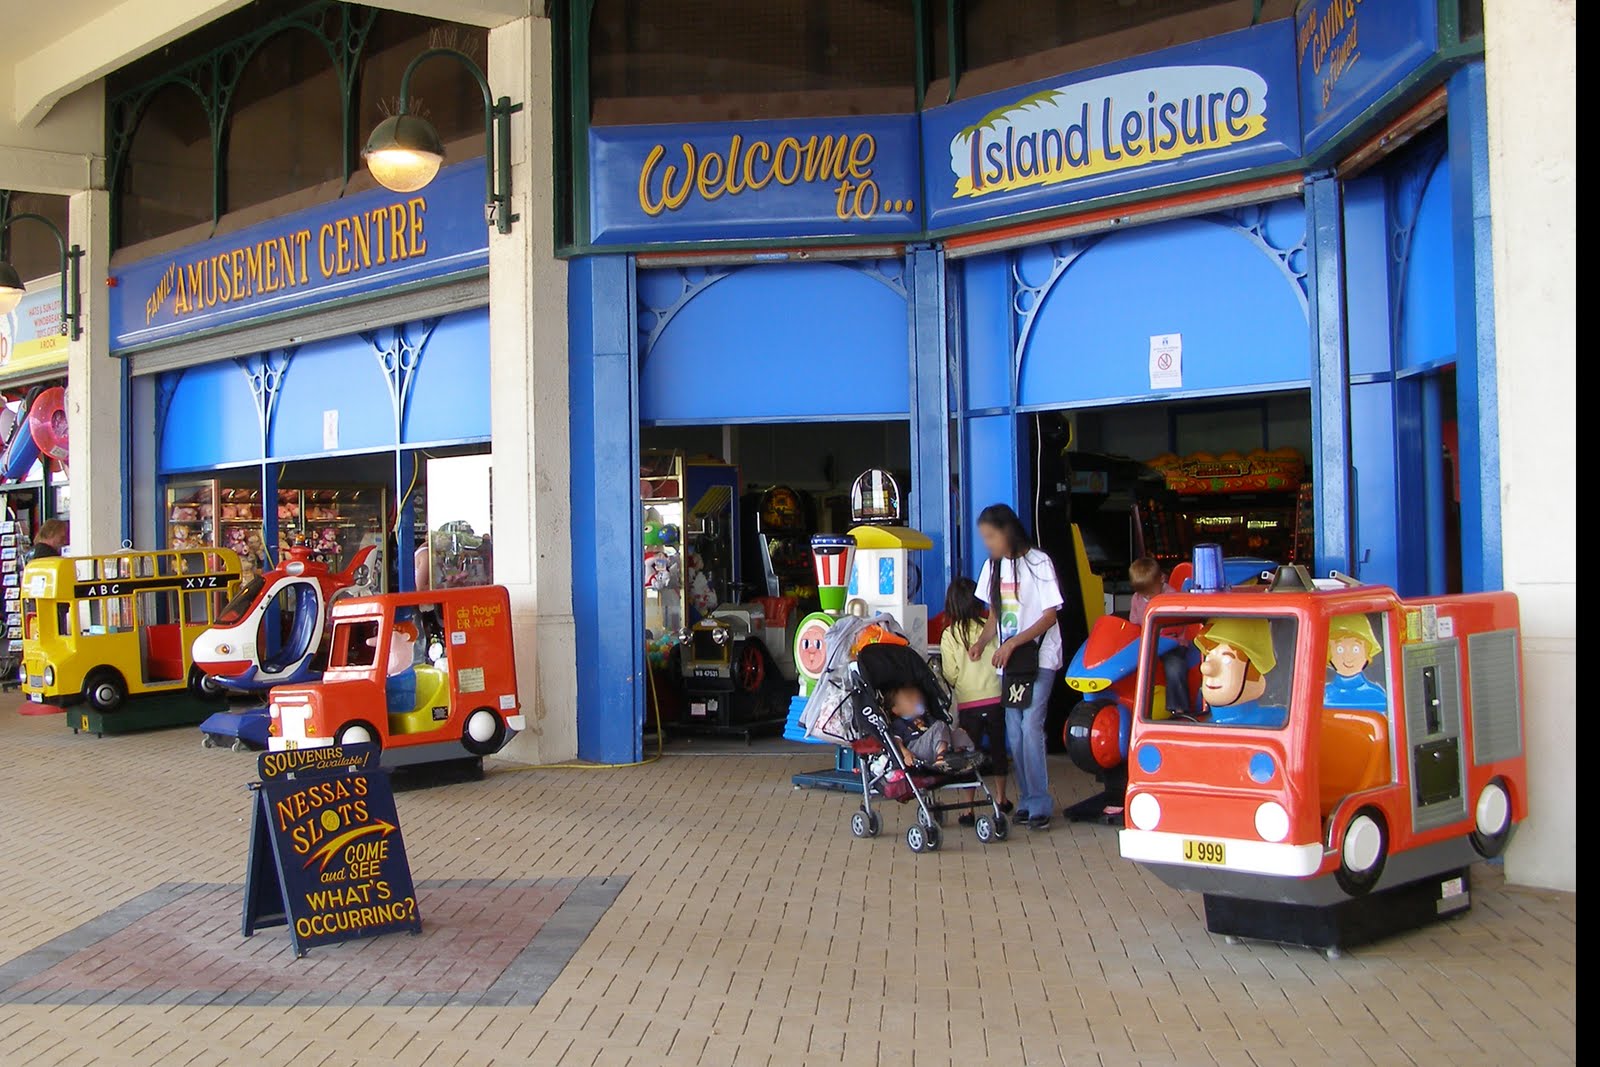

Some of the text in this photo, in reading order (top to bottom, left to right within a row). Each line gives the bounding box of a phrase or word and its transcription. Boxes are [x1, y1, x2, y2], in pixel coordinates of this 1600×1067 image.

[1312, 0, 1345, 75] GAVIN
[970, 86, 1251, 191] Island Leisure
[638, 132, 877, 217] Welcome
[487, 205, 497, 219] 7
[146, 196, 428, 326] FAMILY AMUSEMENT CENTRE
[472, 603, 501, 617] Royal
[473, 617, 496, 628] Mail
[264, 747, 344, 777] SOUVENIRS
[276, 776, 369, 832] NESSA'S
[292, 799, 369, 855] SLOTS
[344, 839, 389, 864] COME
[1185, 841, 1223, 863] J 999
[321, 860, 381, 883] and SEE
[306, 879, 392, 912] WHAT'S
[296, 896, 416, 938] OCCURRING?
